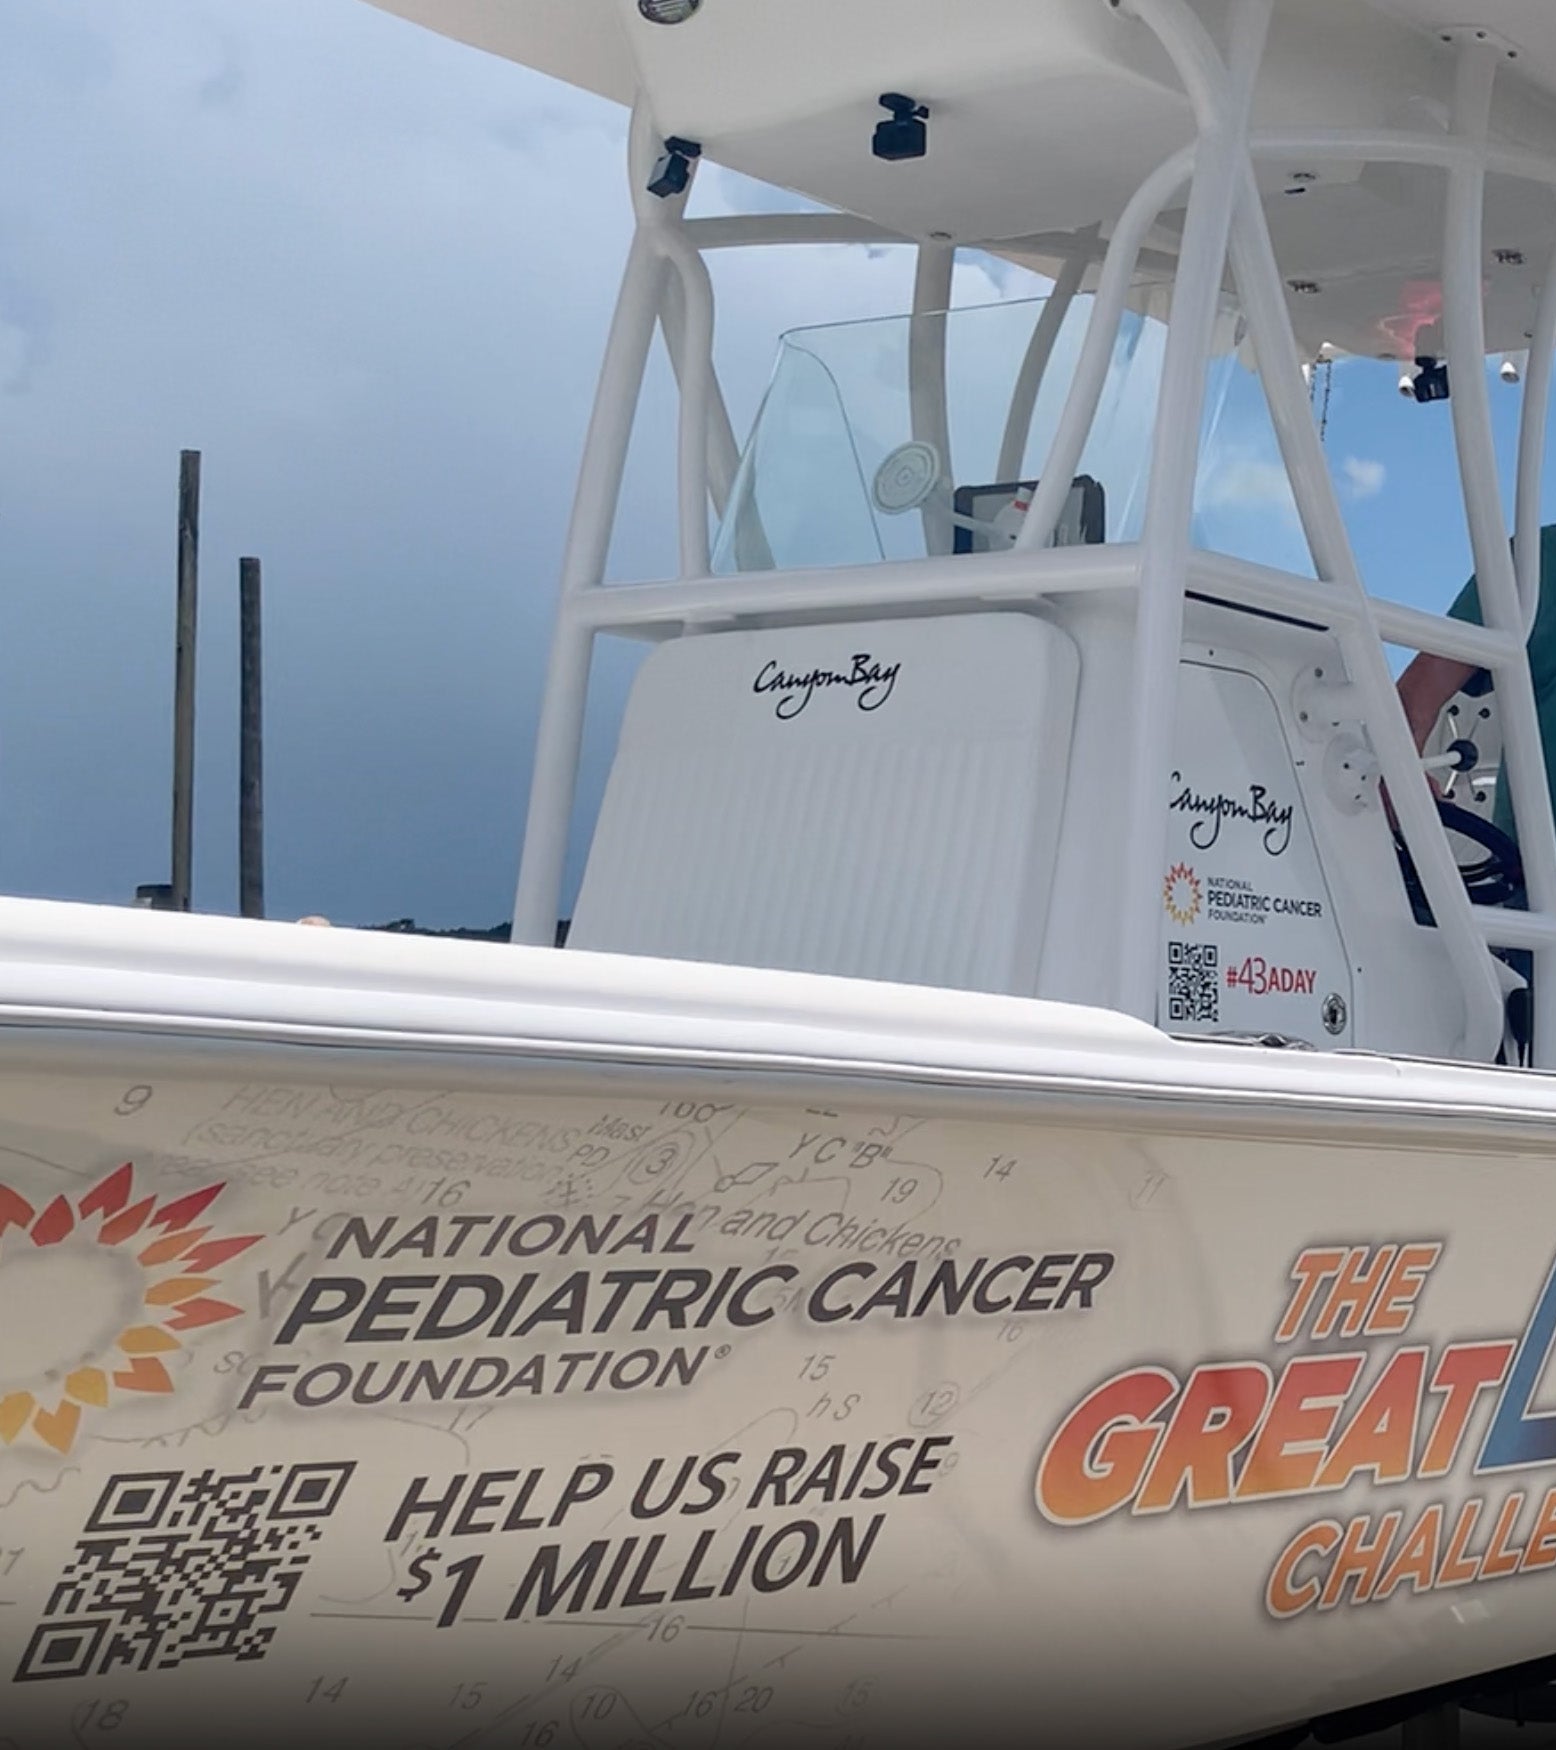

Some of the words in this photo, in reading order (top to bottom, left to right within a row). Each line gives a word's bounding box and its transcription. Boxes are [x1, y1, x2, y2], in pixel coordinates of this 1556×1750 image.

[1207, 876, 1253, 892] NATIONAL
[1207, 889, 1271, 913] PEDIATRIC
[1273, 898, 1322, 918] CANCER
[115, 1084, 152, 1117] 9
[645, 1146, 679, 1176] 3
[983, 1153, 1018, 1182] 14
[421, 1176, 472, 1208] 16
[880, 1176, 919, 1205] 19
[326, 1213, 700, 1258] NATIONAL
[720, 1208, 810, 1243] and
[804, 1209, 962, 1260] Chickens
[273, 1263, 799, 1346] PEDIATRIC
[806, 1252, 1115, 1322] CANCER
[1275, 1242, 1443, 1342] THE
[797, 1351, 837, 1383] 15
[920, 1389, 954, 1418] 12
[1035, 1340, 1518, 1527] GREAT
[384, 1462, 614, 1542] HELP
[630, 1451, 740, 1519] US
[747, 1435, 953, 1509] RAISE
[397, 1546, 484, 1628] $1
[504, 1513, 886, 1621] MILLION
[645, 1612, 685, 1645] 16
[306, 1676, 349, 1704] 14
[683, 1689, 718, 1719] 16
[734, 1685, 774, 1714] 20
[80, 1698, 130, 1731] 18
[577, 1692, 616, 1721] 10
